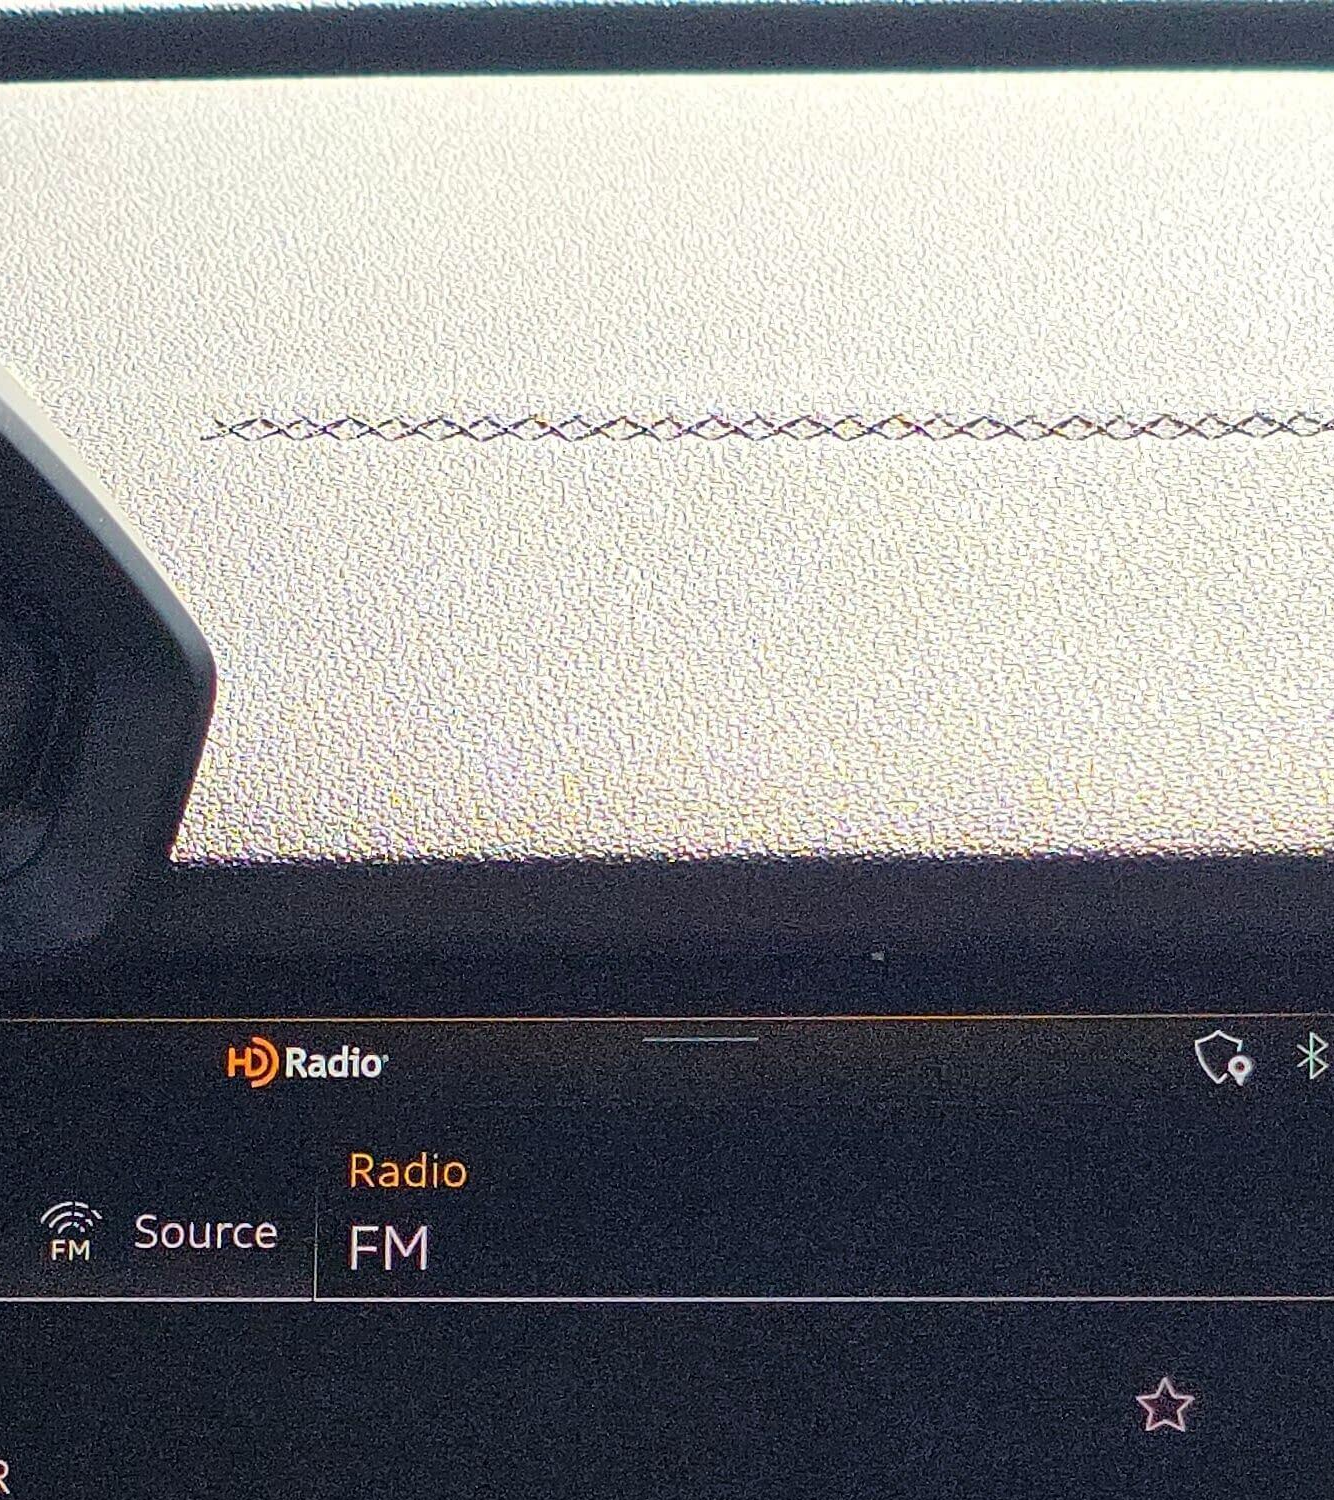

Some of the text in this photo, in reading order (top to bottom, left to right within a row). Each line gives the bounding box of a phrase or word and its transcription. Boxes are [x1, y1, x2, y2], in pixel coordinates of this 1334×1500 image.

[284, 1045, 384, 1079] Radio
[348, 1152, 468, 1189] Radio
[134, 1215, 279, 1249] Source
[348, 1226, 430, 1271] FM
[50, 1239, 92, 1262] FM
